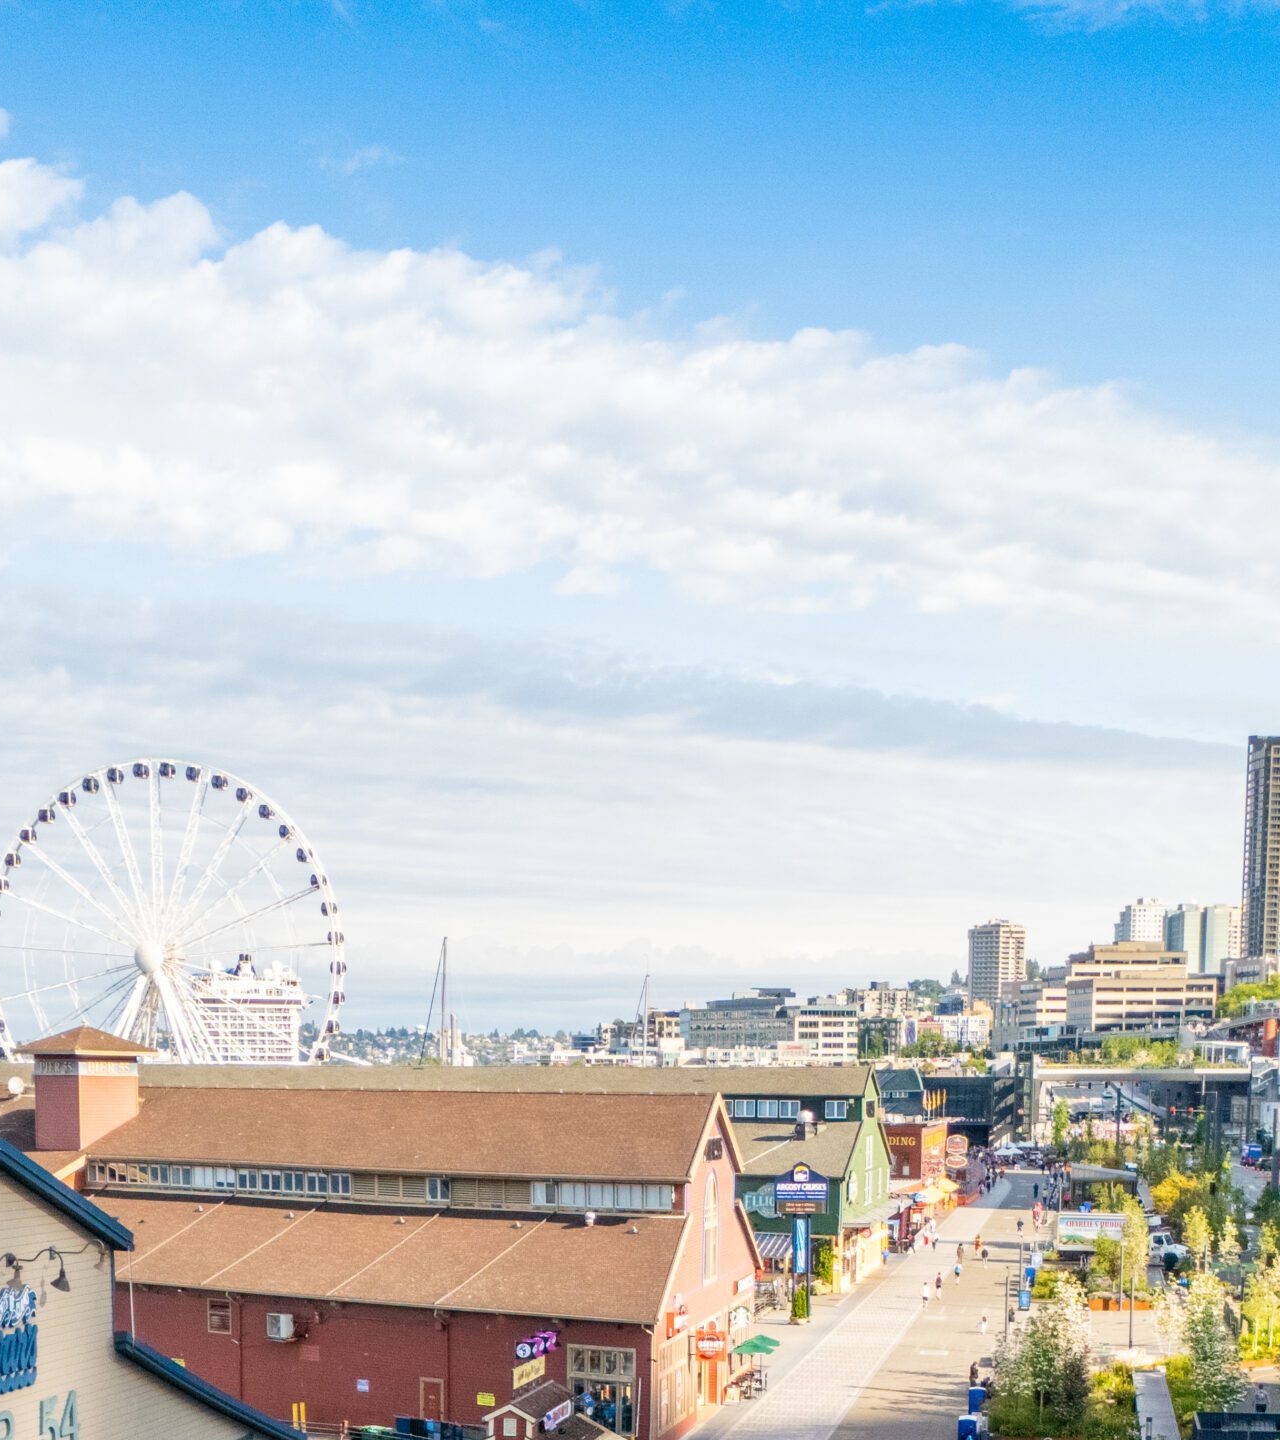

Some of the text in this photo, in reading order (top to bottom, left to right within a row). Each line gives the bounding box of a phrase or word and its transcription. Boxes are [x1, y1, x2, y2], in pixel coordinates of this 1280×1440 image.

[40, 1061, 73, 1073] PIER 55
[776, 1183, 827, 1191] ARGOSY CRUISES
